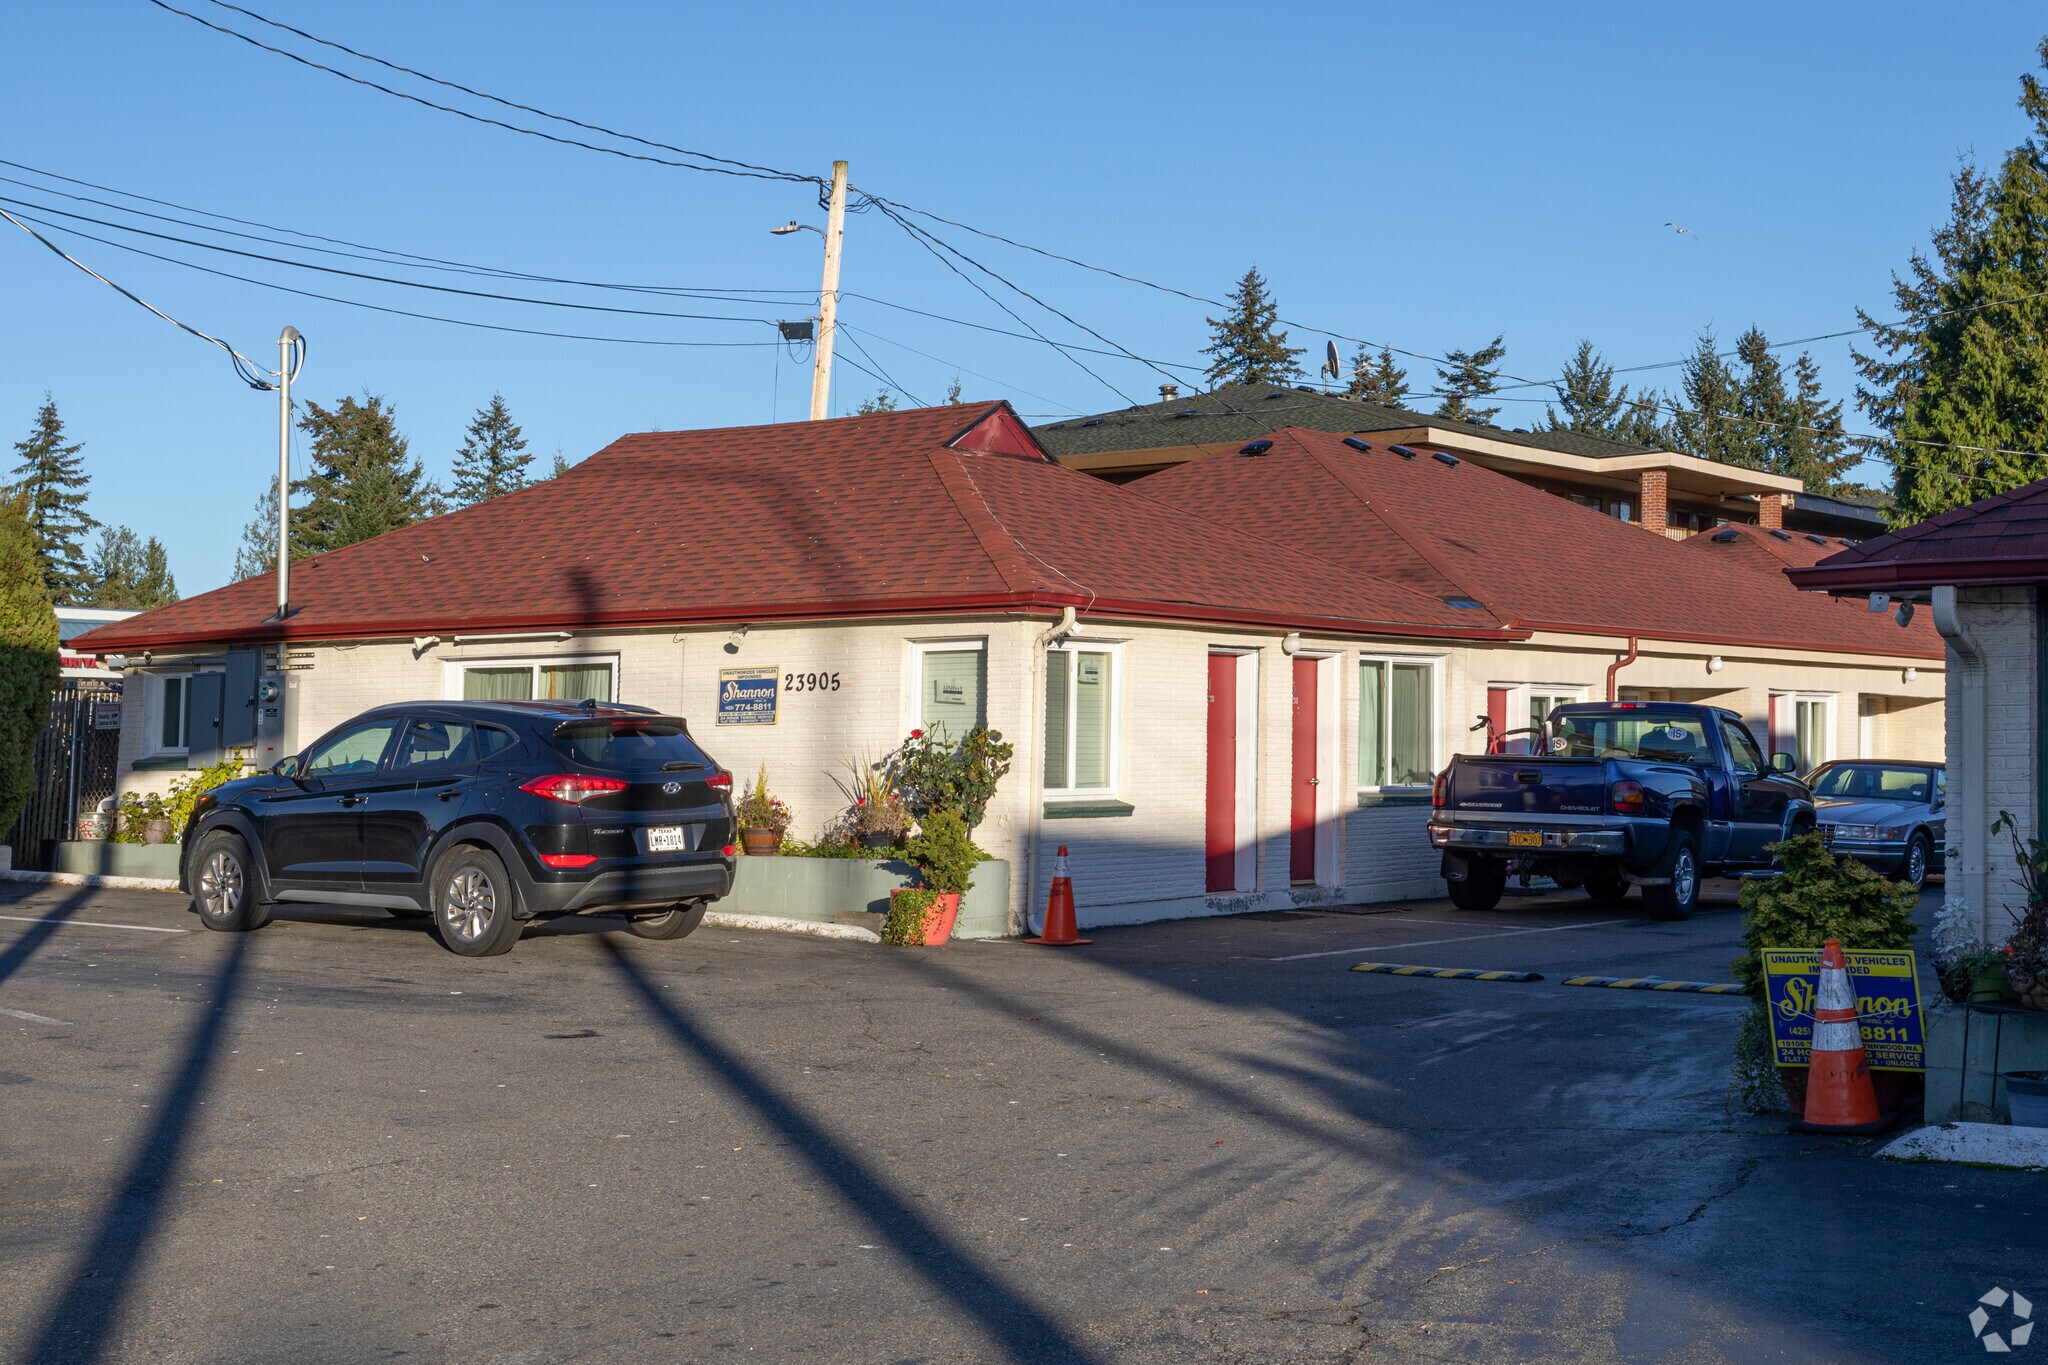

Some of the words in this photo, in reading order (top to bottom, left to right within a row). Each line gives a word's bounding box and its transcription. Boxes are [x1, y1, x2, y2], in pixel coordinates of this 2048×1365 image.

[61, 657, 98, 668] ERIYA
[785, 672, 840, 691] 23905
[722, 681, 774, 702] Shannon
[735, 703, 771, 711] 774-8811
[1771, 956, 1851, 964] UNAUTHOD
[1855, 956, 1905, 966] VEHICLES
[1779, 977, 1911, 1019] Shnon
[1789, 1027, 1811, 1035] (425)
[1861, 1026, 1908, 1041] 8811
[1876, 1051, 1920, 1060] SERVICE
